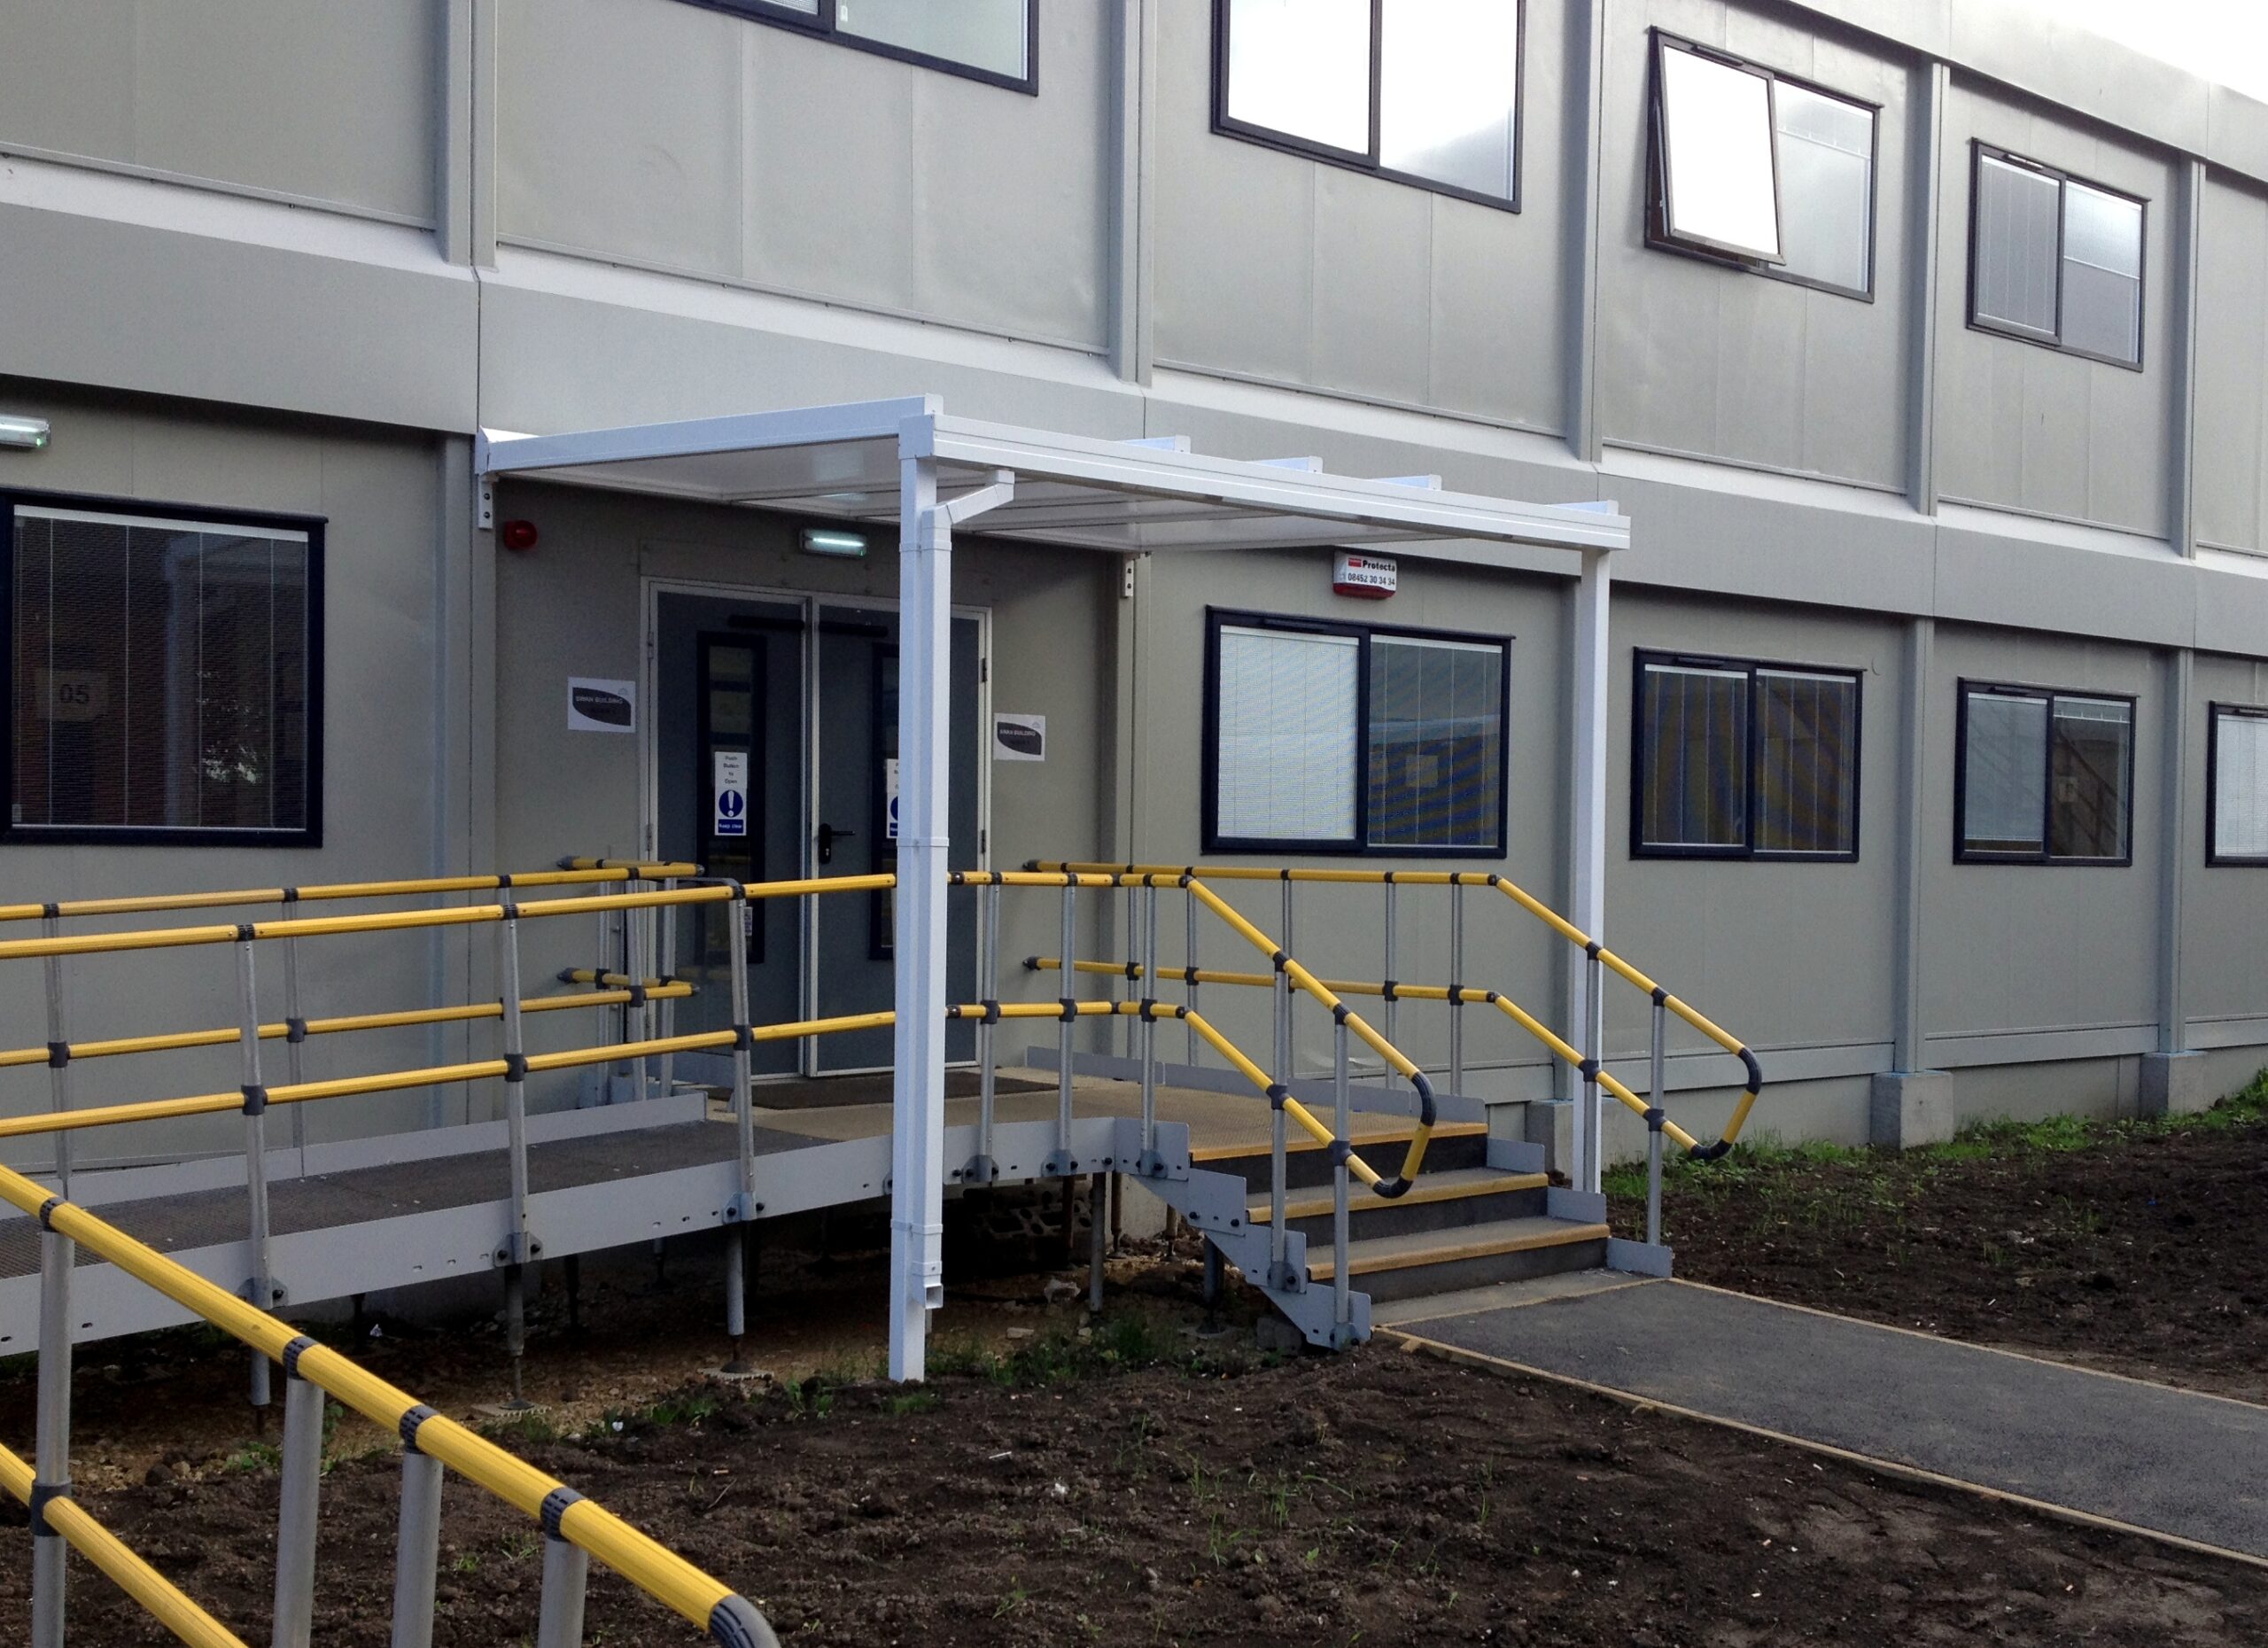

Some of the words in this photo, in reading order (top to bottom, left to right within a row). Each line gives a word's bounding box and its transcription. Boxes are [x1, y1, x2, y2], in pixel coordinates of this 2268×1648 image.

[1363, 560, 1395, 572] Protecta
[1348, 572, 1368, 583] 08452
[1369, 575, 1378, 584] 30
[1379, 576, 1386, 585] 34
